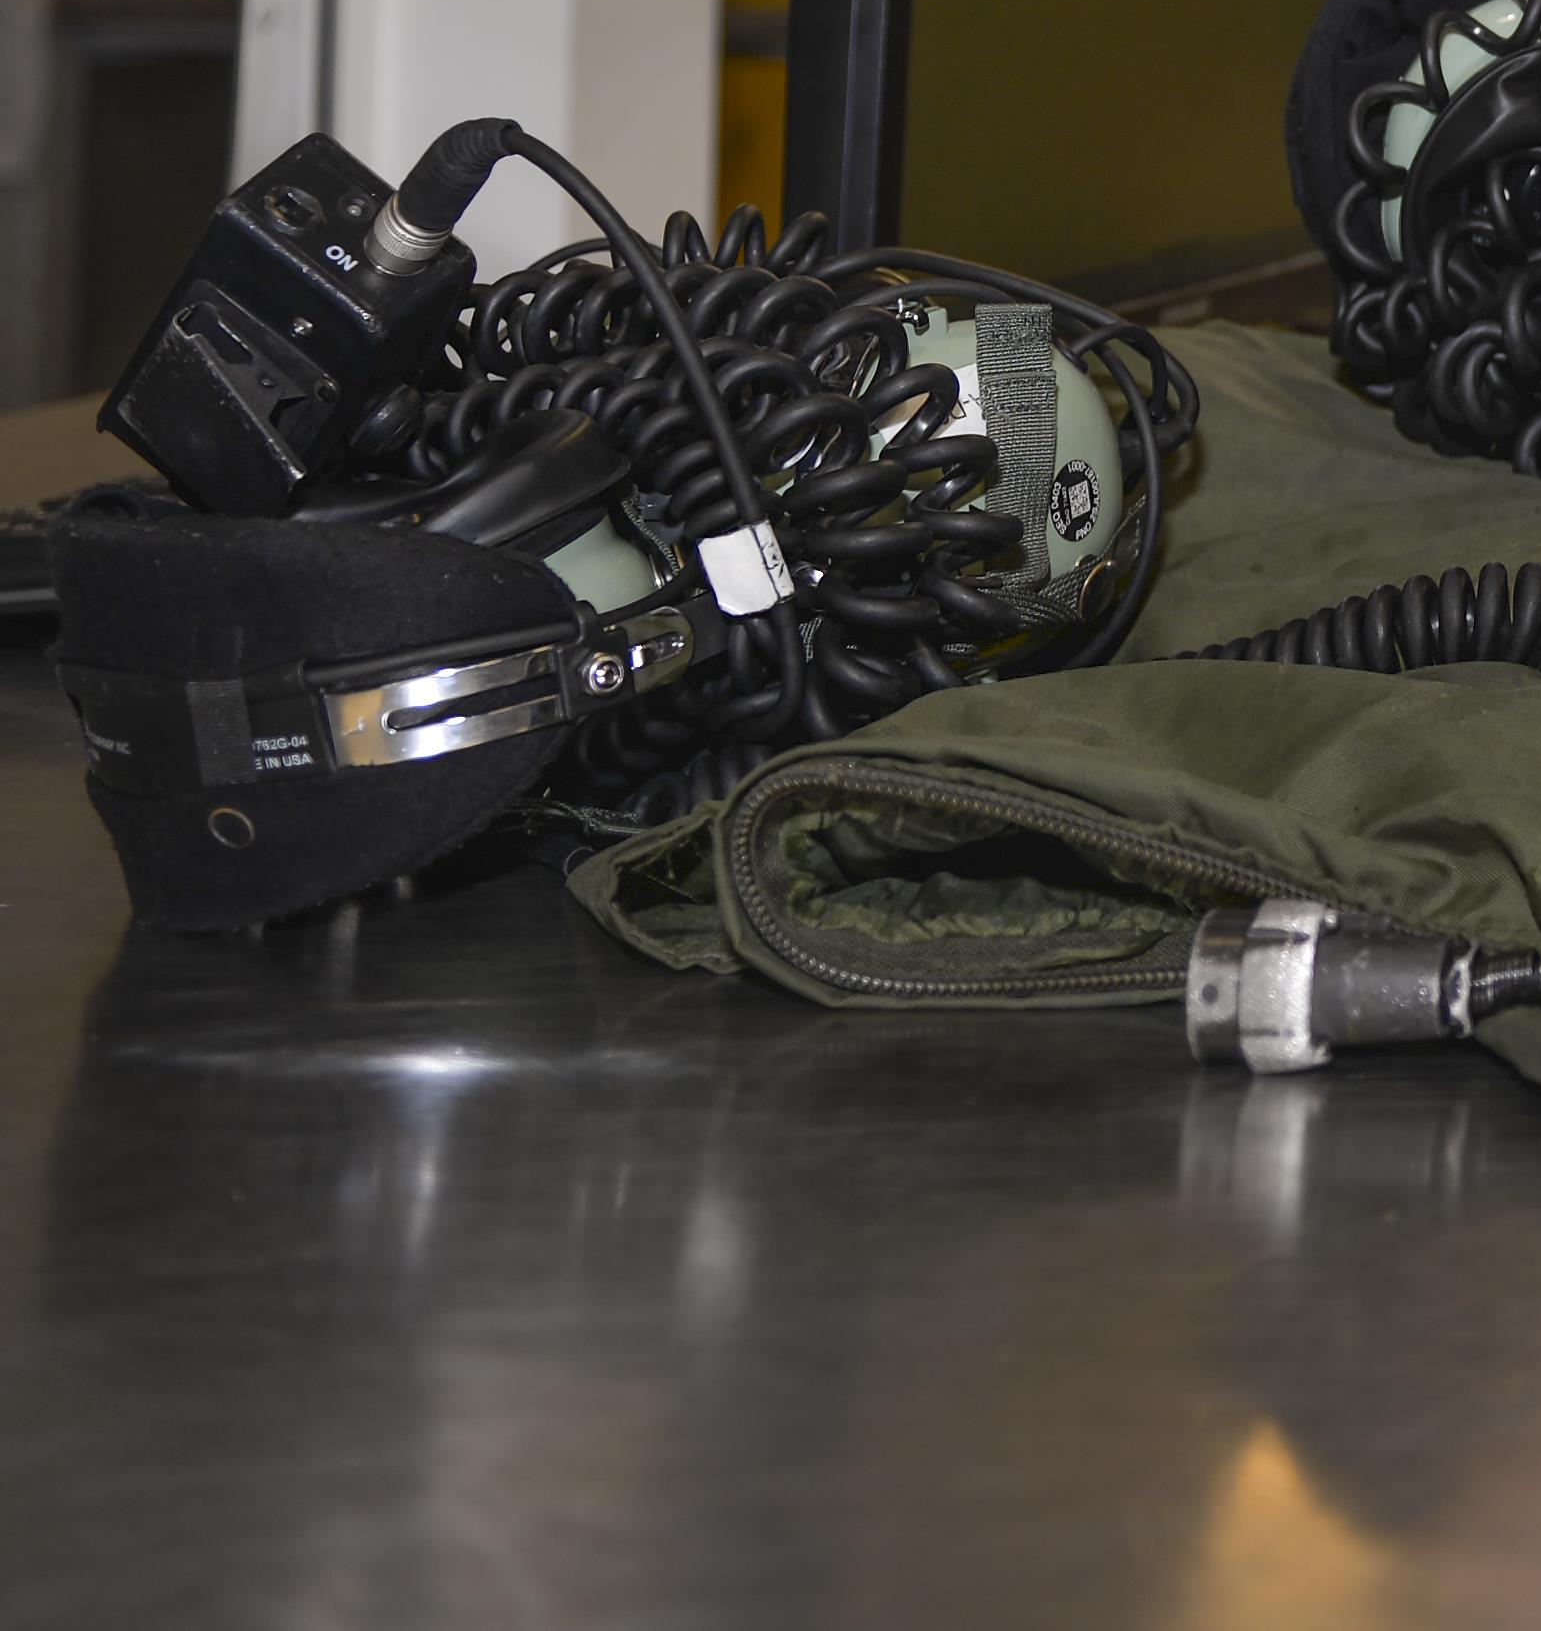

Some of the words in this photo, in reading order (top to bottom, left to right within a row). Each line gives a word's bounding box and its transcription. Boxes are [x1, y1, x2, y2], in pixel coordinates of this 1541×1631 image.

[326, 245, 359, 271] ON
[265, 757, 281, 769] IN
[282, 753, 313, 767] USA
